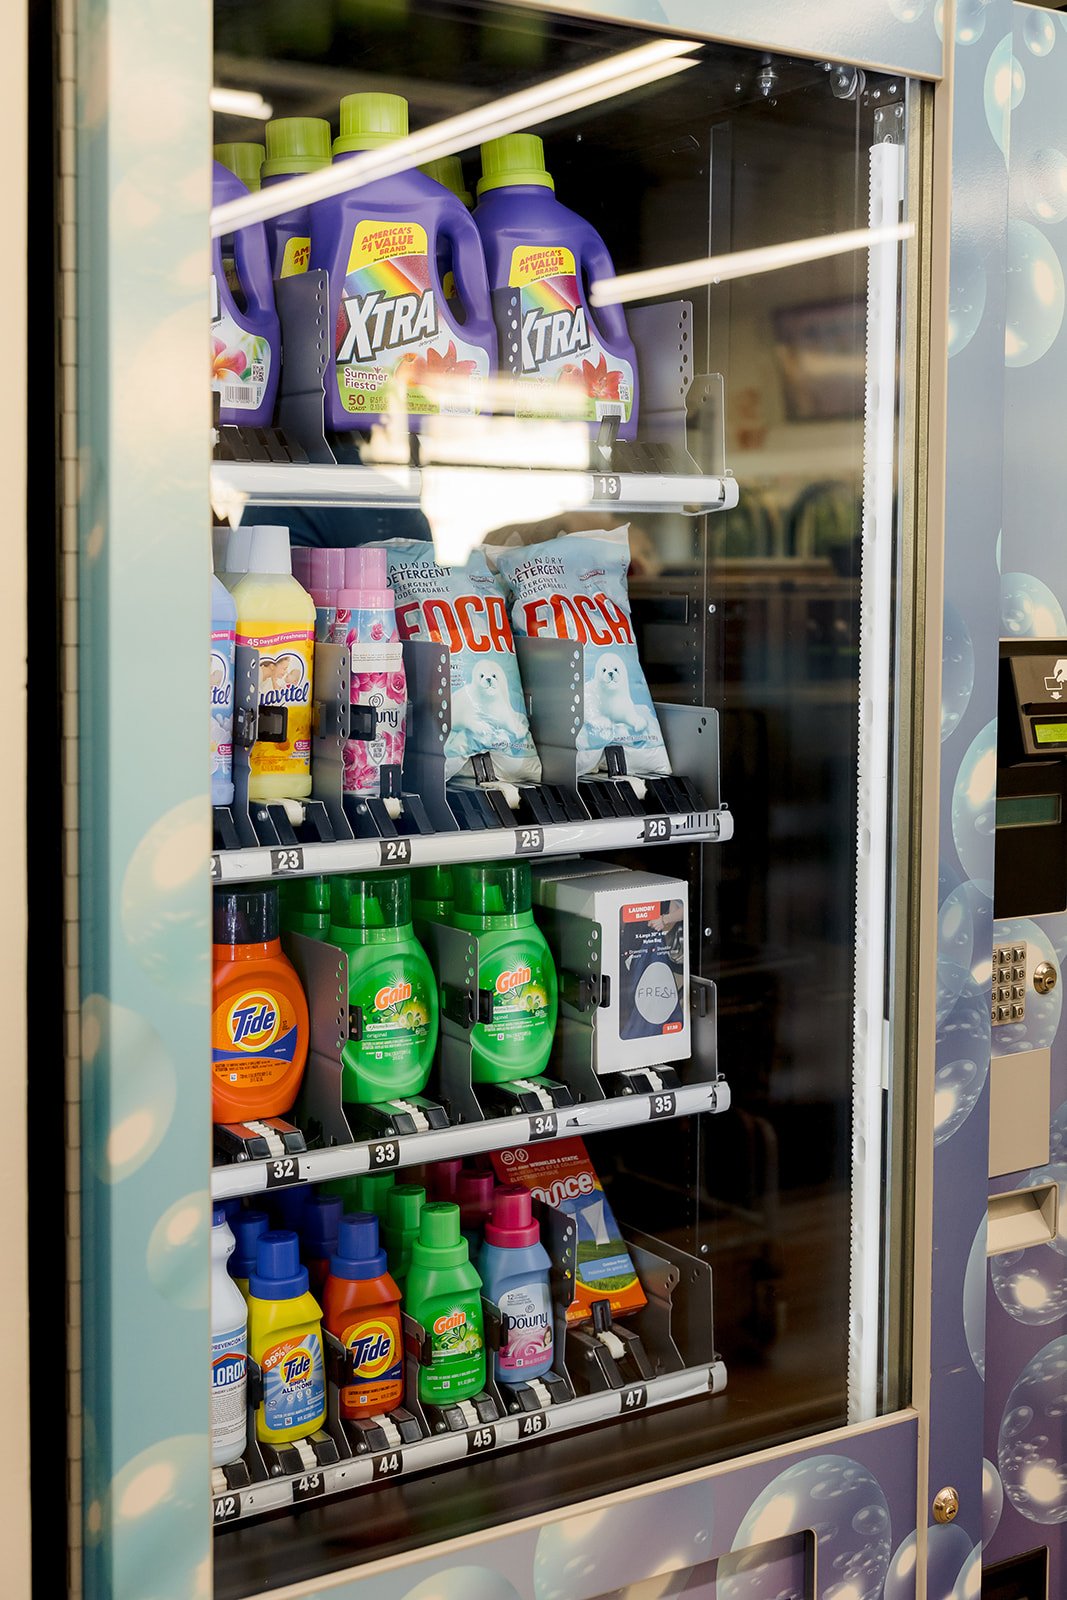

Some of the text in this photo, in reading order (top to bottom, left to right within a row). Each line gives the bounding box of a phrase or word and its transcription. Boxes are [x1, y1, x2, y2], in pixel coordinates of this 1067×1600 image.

[361, 227, 413, 245] AMERICA'S
[361, 234, 414, 253] #1 VALUE
[379, 245, 407, 256] BRAND
[519, 249, 562, 267] AMERICA'S
[519, 256, 564, 274] #1 VALUE
[535, 266, 559, 276] BRAND
[336, 289, 438, 364] XTRA
[344, 367, 388, 382] Summer
[345, 378, 377, 391] Fiesta
[348, 394, 365, 406] 50
[599, 477, 618, 494] 13
[389, 560, 440, 574] AUNDR
[508, 556, 563, 580] LAUNDRY
[511, 564, 566, 586] DETERGENT
[395, 586, 450, 601] IODEGRADABLE
[395, 595, 516, 654] FOCA
[522, 593, 635, 647] FOCA
[247, 638, 260, 647] 45
[259, 637, 274, 645] Days
[280, 633, 308, 641] Freshness
[649, 820, 667, 837] 26
[521, 830, 540, 848] 25
[277, 851, 300, 869] 23
[386, 842, 407, 860] 24
[628, 905, 656, 914] LAUNDRY
[1005, 953, 1011, 961] 3
[1019, 951, 1025, 960] A
[496, 967, 531, 994] Gain
[1005, 972, 1011, 980] 6
[375, 982, 412, 1010] Gain
[1005, 991, 1010, 999] 9
[1018, 989, 1024, 997] C
[1017, 1007, 1024, 1016] D
[232, 1003, 277, 1044] Tide
[654, 1095, 672, 1113] 35
[535, 1115, 554, 1134] 34
[375, 1143, 396, 1163] 33
[273, 1159, 294, 1179] 32
[531, 1172, 594, 1209] ounce
[433, 1312, 467, 1335] Gain
[507, 1312, 548, 1330] Downy
[264, 1349, 286, 1368] 99%
[350, 1333, 391, 1370] Tide
[211, 1357, 246, 1387] LOROX
[284, 1356, 311, 1383] Tide
[282, 1386, 294, 1394] ALL
[302, 1380, 313, 1389] ONE
[625, 1388, 643, 1407] 47
[524, 1415, 542, 1434] 46
[472, 1429, 493, 1448] 45
[379, 1454, 399, 1474] 44
[299, 1474, 320, 1492] 43
[215, 1496, 236, 1518] 42
